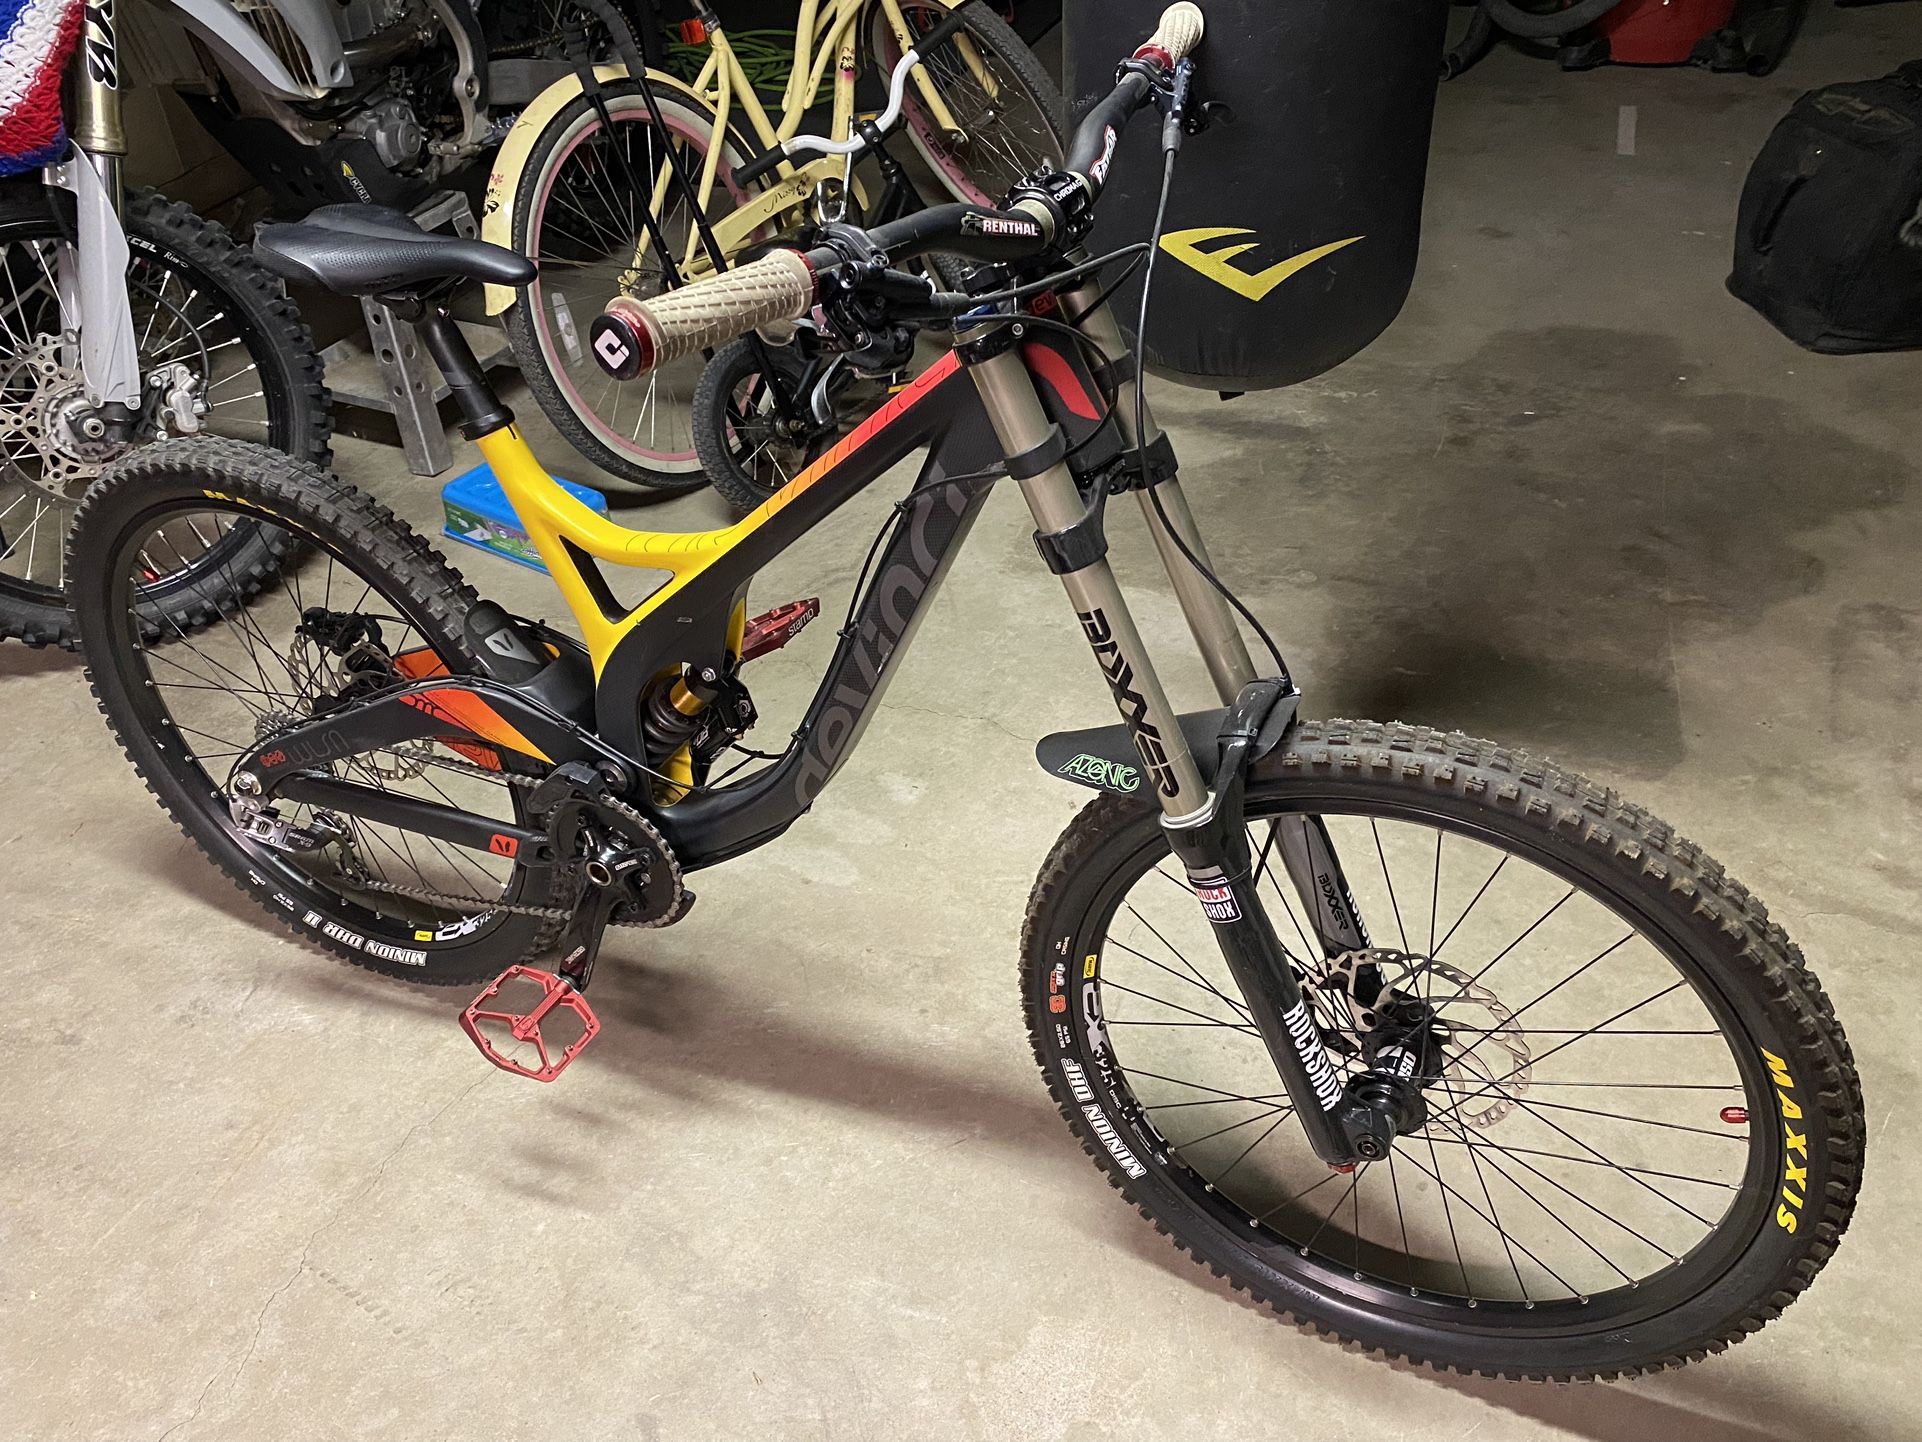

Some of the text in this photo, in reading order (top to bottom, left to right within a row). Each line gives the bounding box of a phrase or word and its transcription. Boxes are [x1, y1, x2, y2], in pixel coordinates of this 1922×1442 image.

[84, 0, 118, 90] YB
[1053, 179, 1083, 202] CHROMAG
[982, 220, 1040, 236] RENTHAL
[788, 608, 814, 637] stamp
[1057, 754, 1141, 793] AZONIC
[1203, 901, 1236, 919] SHOX
[1317, 873, 1349, 931] BOXXER
[302, 910, 428, 967] MINION DHR II
[1060, 1058, 1095, 1103] DHF
[1282, 998, 1344, 1112] ROCKSHOX
[1081, 1103, 1148, 1180] MINION
[1760, 1046, 1808, 1234] MAXXIS
